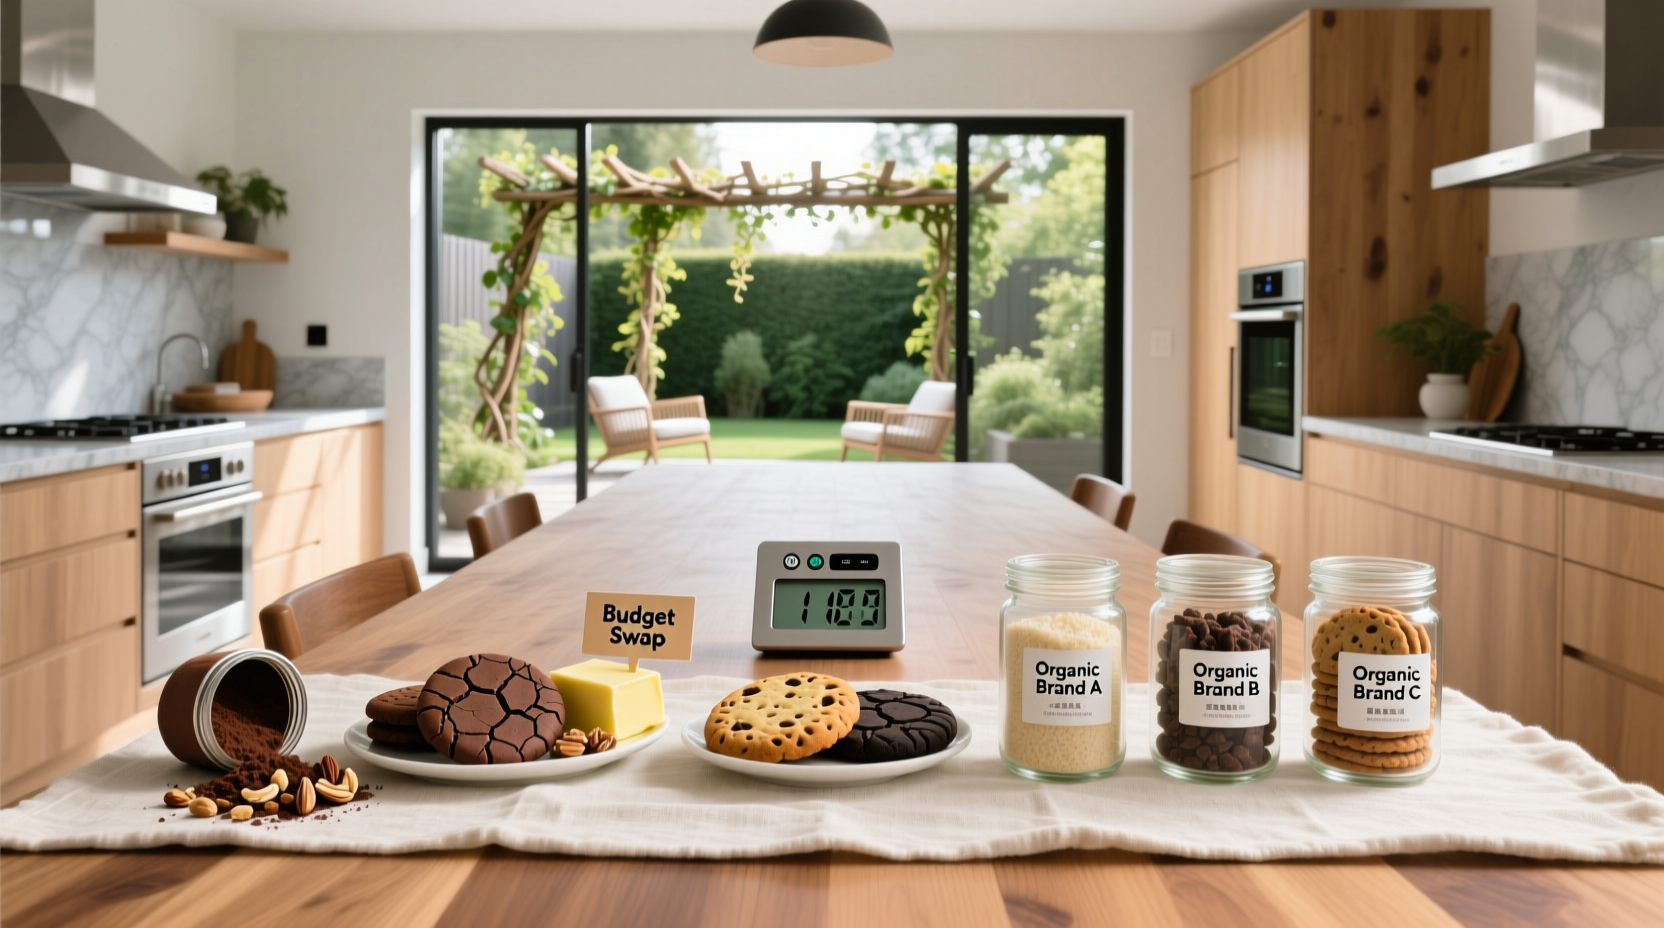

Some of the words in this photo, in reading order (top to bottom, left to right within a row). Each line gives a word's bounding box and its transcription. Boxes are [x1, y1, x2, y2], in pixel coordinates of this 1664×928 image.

[603, 604, 675, 629] Budget
[610, 626, 666, 651] Swap
[1036, 661, 1100, 681] Organic
[1193, 662, 1258, 682] Organic
[1353, 665, 1421, 685] Organic
[1036, 679, 1085, 695] Brand
[1090, 680, 1102, 695] A
[1194, 681, 1244, 696] Brand
[1249, 681, 1260, 696] B
[1354, 684, 1405, 700] Brand
[1409, 685, 1421, 700] C
